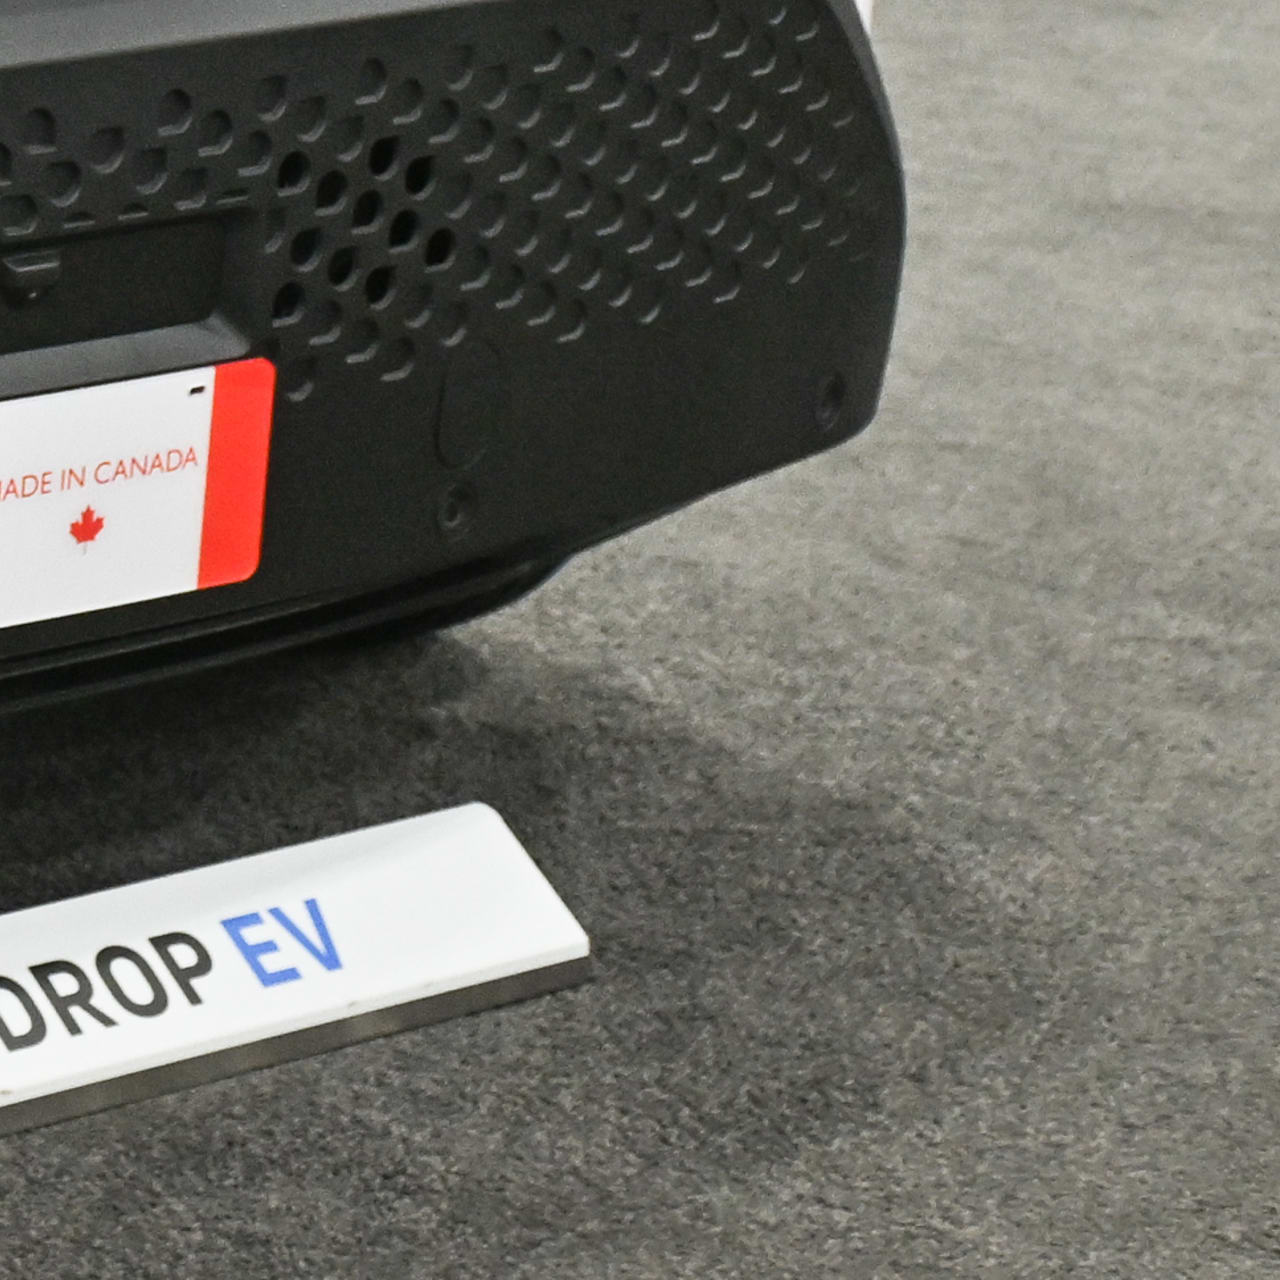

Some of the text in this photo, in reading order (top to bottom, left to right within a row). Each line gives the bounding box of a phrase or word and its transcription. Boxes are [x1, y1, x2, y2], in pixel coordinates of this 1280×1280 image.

[60, 466, 86, 490] IN
[94, 446, 198, 485] CANADA
[218, 898, 344, 988] EV
